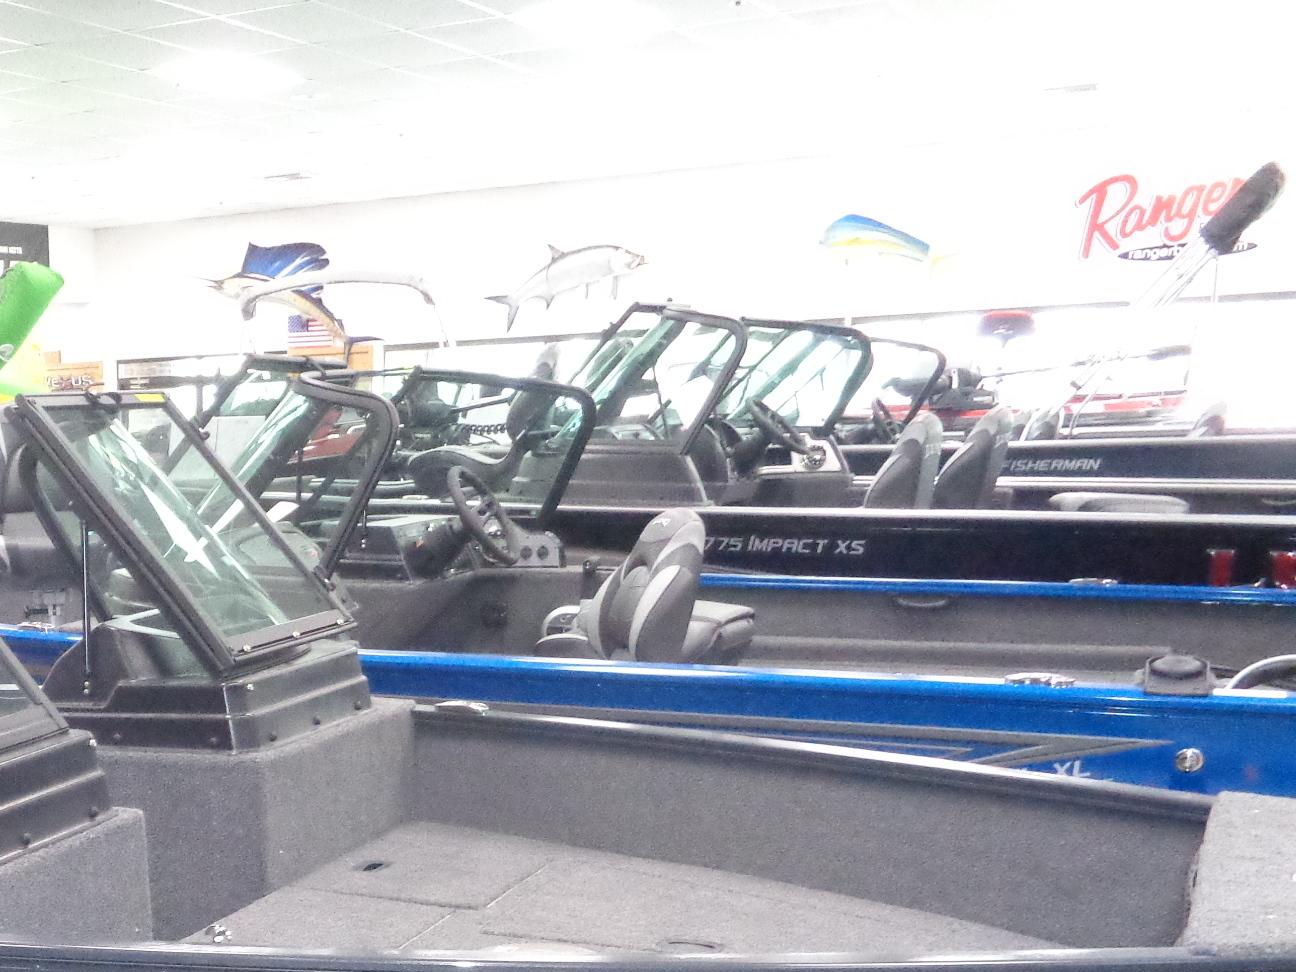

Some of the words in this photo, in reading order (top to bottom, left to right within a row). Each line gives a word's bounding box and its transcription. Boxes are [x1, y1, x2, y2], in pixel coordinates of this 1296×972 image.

[1075, 175, 1249, 259] Ranger
[1002, 458, 1101, 471] FISHERMAN
[704, 536, 743, 551] 775
[748, 536, 828, 553] IMPACT
[834, 540, 866, 554] XS
